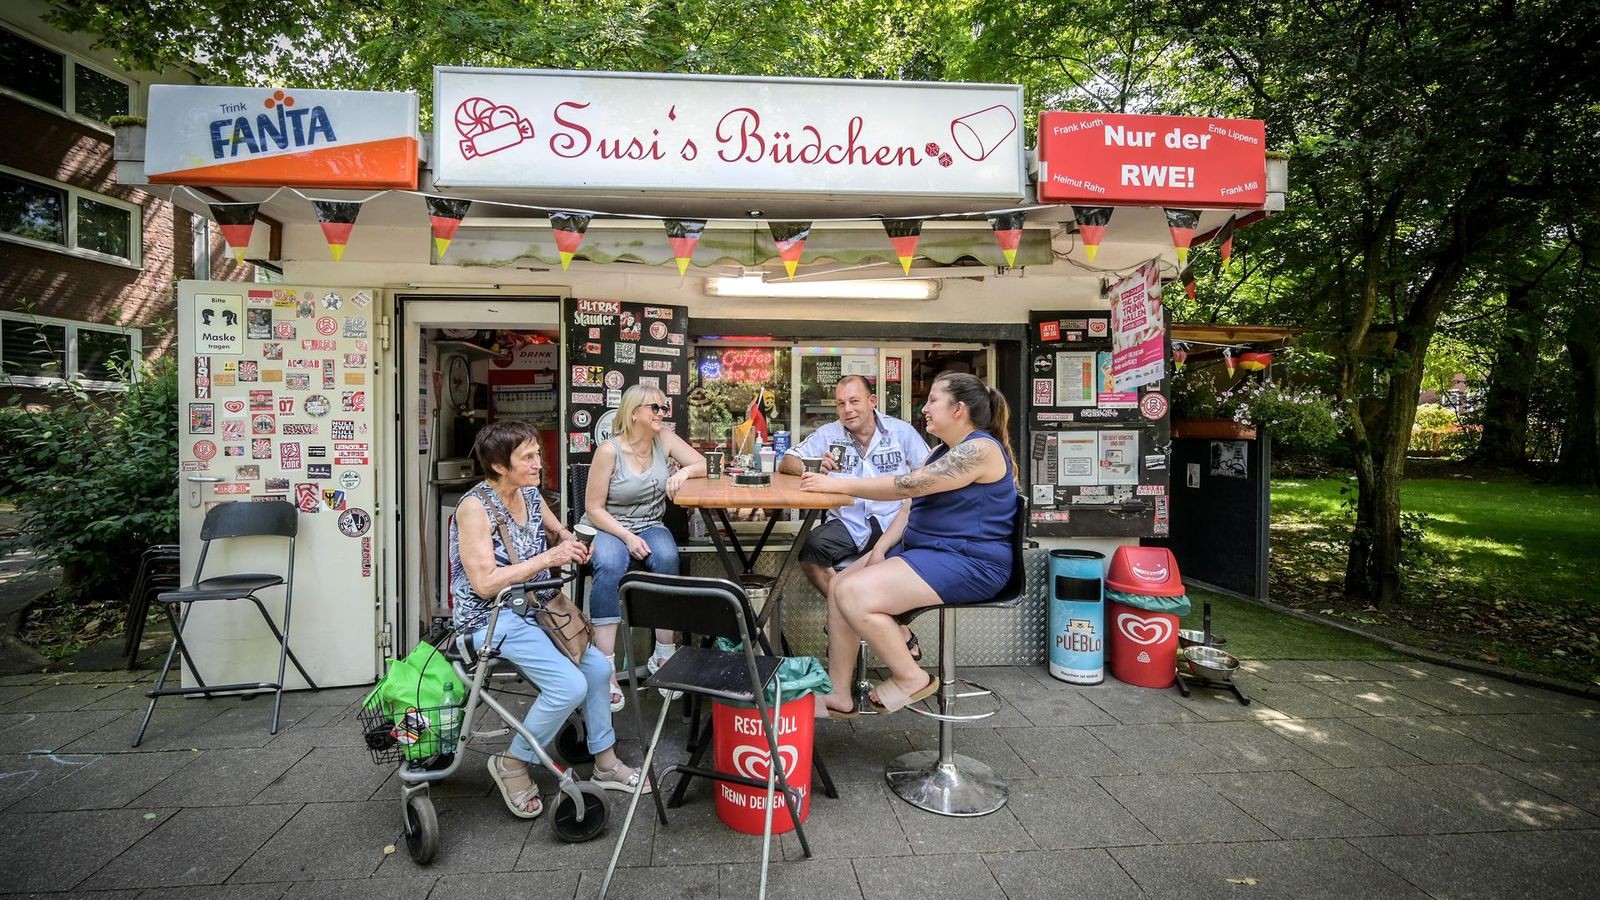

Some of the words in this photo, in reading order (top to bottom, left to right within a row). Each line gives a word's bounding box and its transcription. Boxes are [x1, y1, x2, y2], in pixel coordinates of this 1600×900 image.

[220, 102, 247, 114] Trink
[209, 104, 337, 159] FANTA
[1053, 122, 1079, 136] Frank
[1080, 118, 1104, 130] Kurth
[1208, 123, 1227, 137] Ente
[1228, 128, 1259, 145] Lippens
[715, 107, 922, 167] Büdchen
[1104, 125, 1156, 147] Nur
[1164, 128, 1212, 150] der
[1053, 173, 1083, 188] Helmut
[1084, 180, 1106, 194] Rahn
[1121, 164, 1195, 188] RWE!
[1220, 185, 1243, 196] Frank
[1244, 181, 1259, 192] Mill
[579, 299, 619, 314] ULTRAS
[1123, 299, 1145, 316] TRINK
[202, 333, 236, 341] Maske
[722, 349, 772, 366] Coffee
[872, 450, 902, 466] CLUB
[1056, 633, 1102, 652] PUEBLO
[734, 715, 798, 736] RESTLL
[721, 784, 746, 807] TRENN
